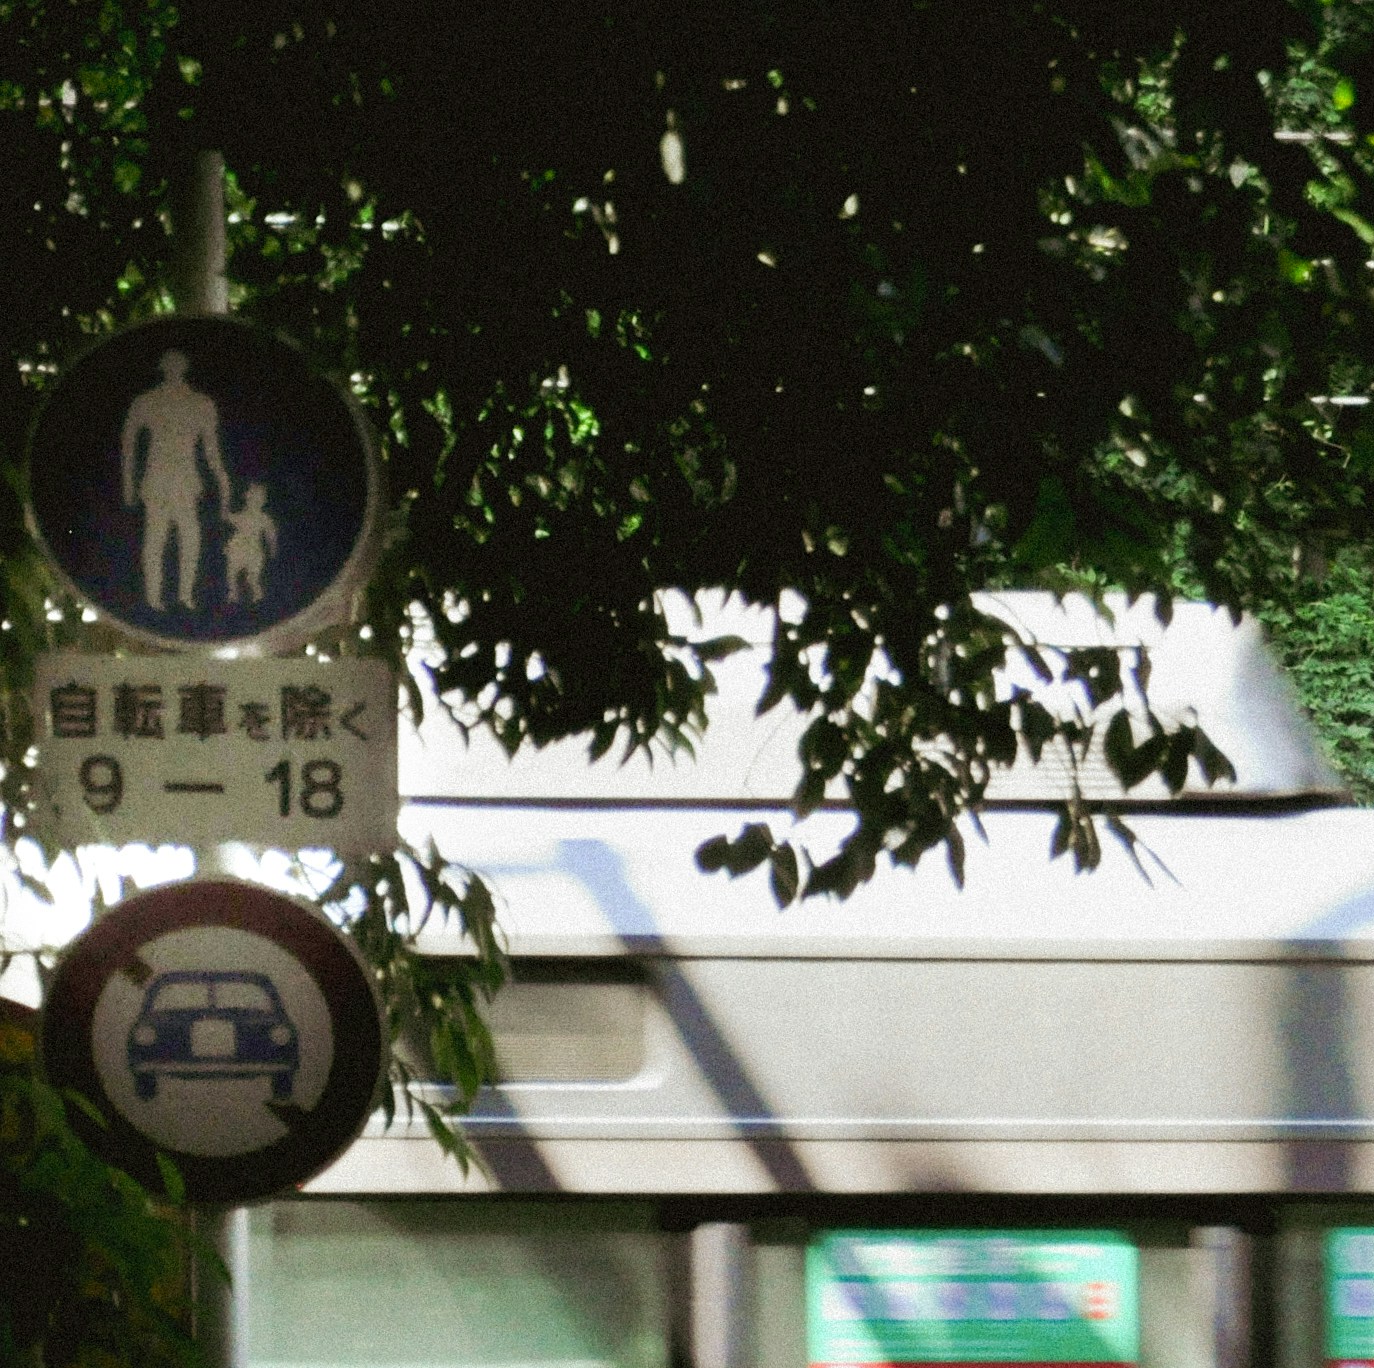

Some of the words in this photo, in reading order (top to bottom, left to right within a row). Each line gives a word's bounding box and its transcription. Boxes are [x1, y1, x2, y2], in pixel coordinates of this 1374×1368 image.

[51, 681, 367, 741] 自転車を除く
[80, 754, 123, 814] 9
[265, 759, 344, 818] 18
